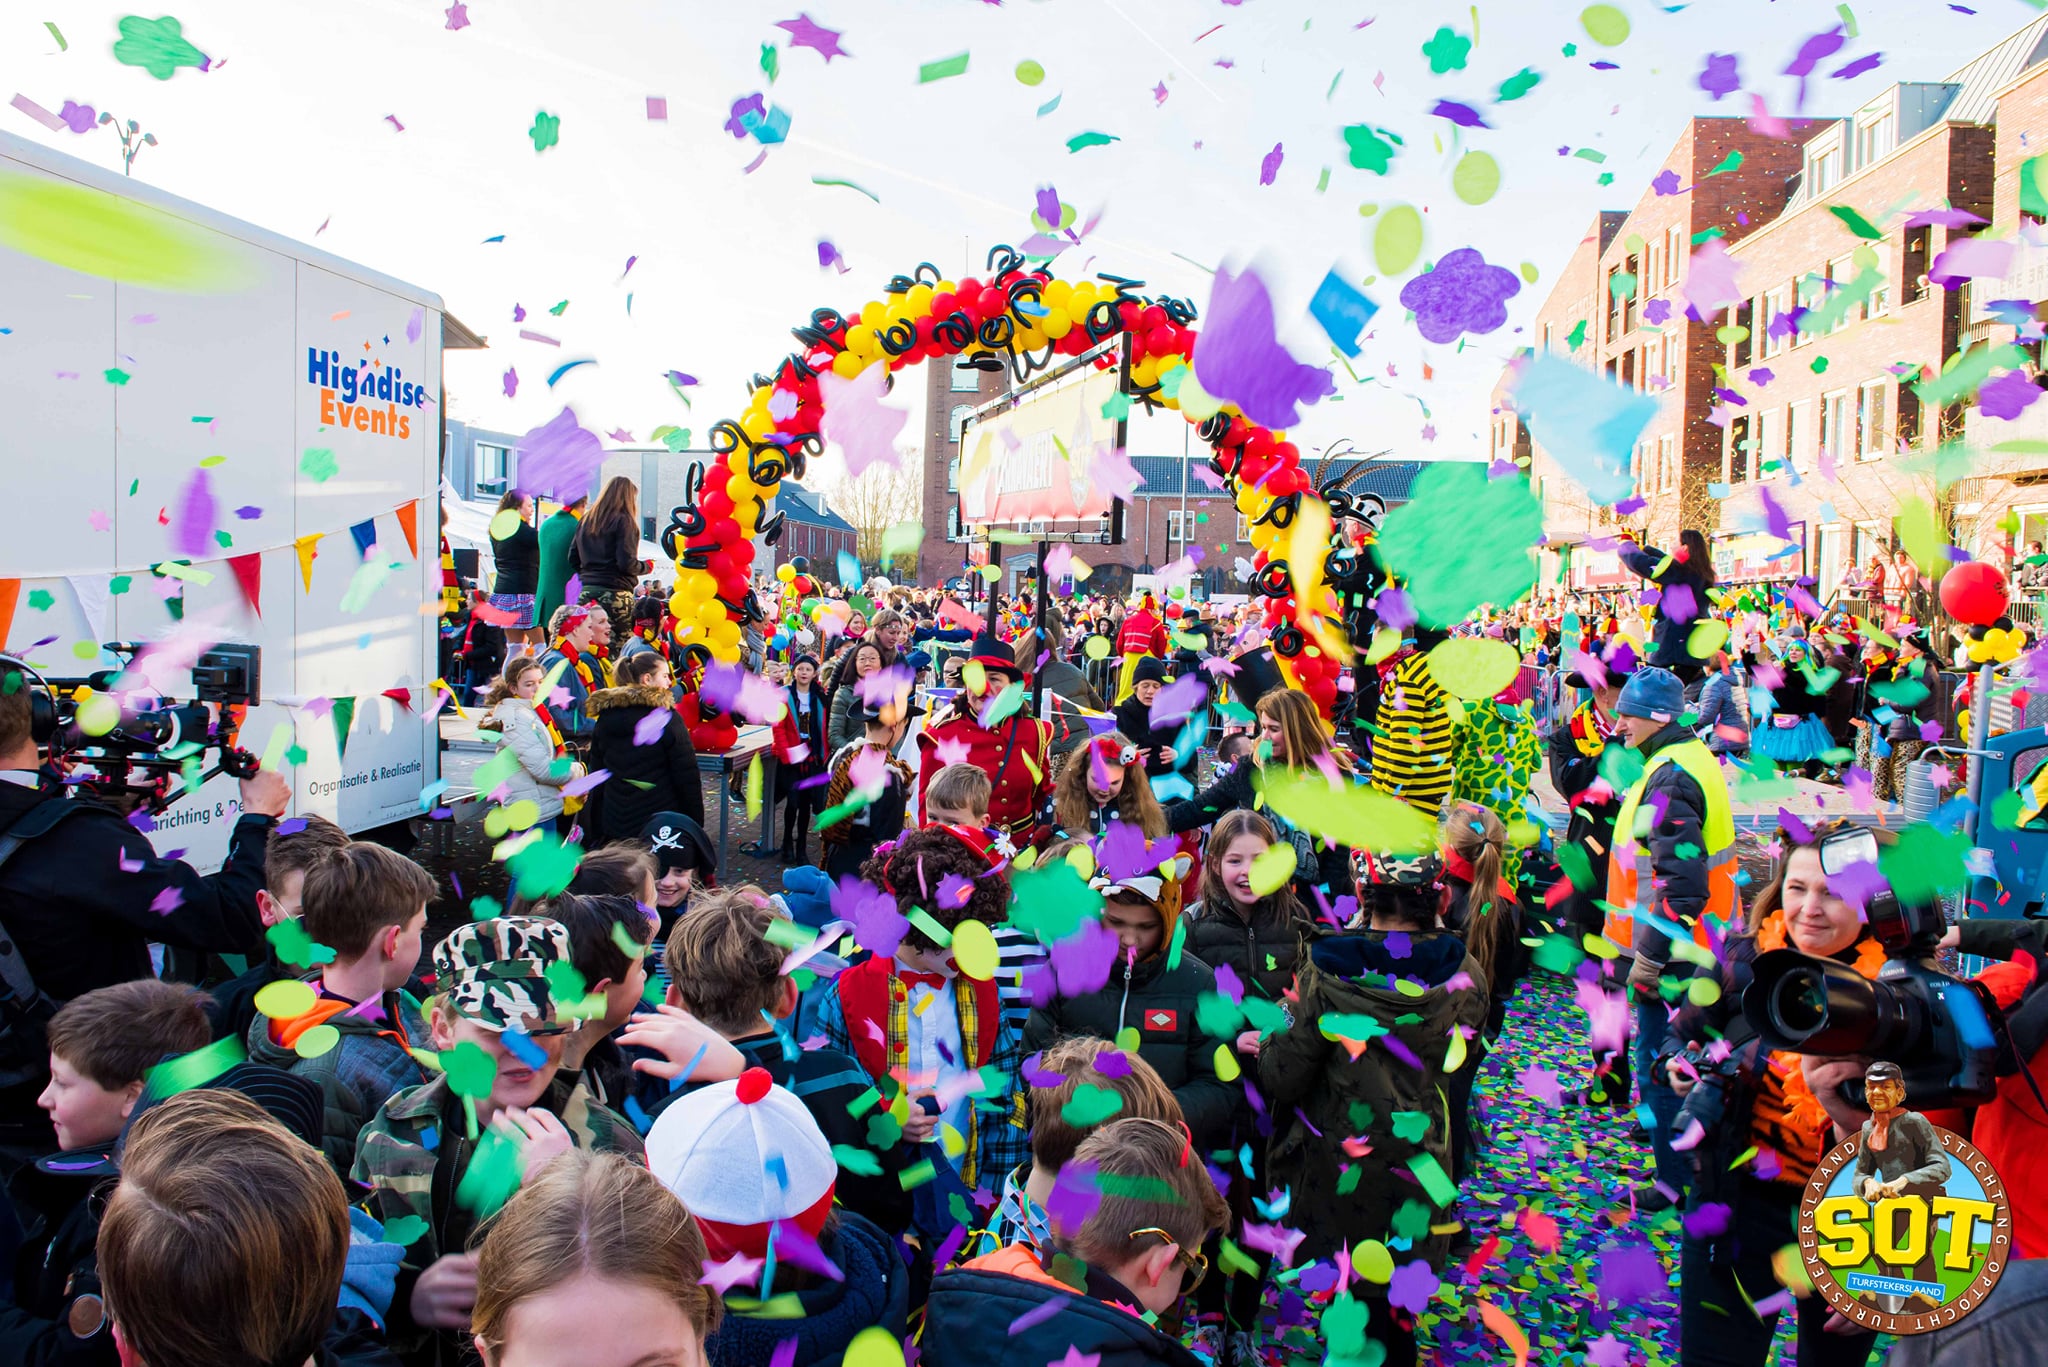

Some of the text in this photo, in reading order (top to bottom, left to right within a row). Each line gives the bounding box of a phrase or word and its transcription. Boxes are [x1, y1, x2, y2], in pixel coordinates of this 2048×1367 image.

[321, 388, 410, 440] Events
[309, 760, 421, 796] Organisatie & Realisatie
[215, 802, 224, 817] &
